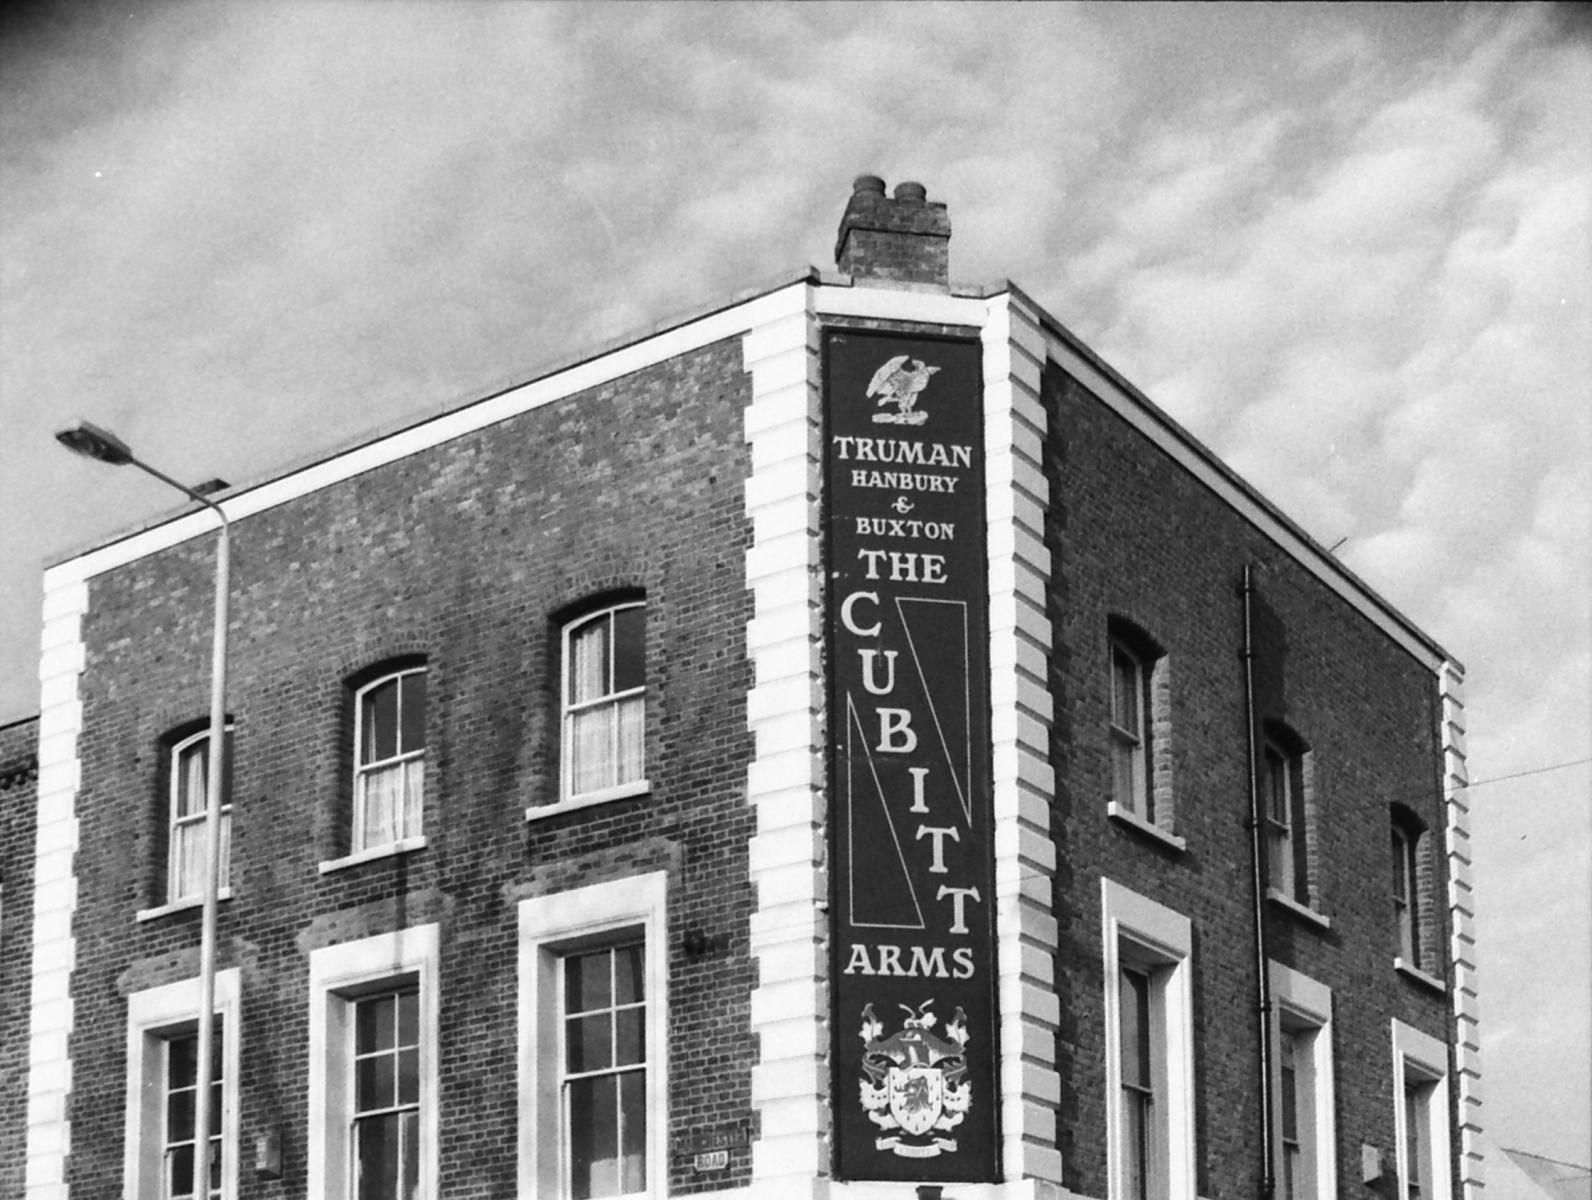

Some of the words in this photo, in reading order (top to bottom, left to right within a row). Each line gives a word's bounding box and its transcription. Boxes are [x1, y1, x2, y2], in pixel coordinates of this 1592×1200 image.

[833, 435, 973, 468] TRUMAN
[851, 469, 960, 493] HANBURY
[891, 495, 915, 514] &
[856, 516, 956, 541] BUXTON
[857, 548, 949, 585] THE
[841, 590, 981, 935] CUBITT
[844, 944, 976, 980] ARMS
[697, 1152, 725, 1169] ROAD
